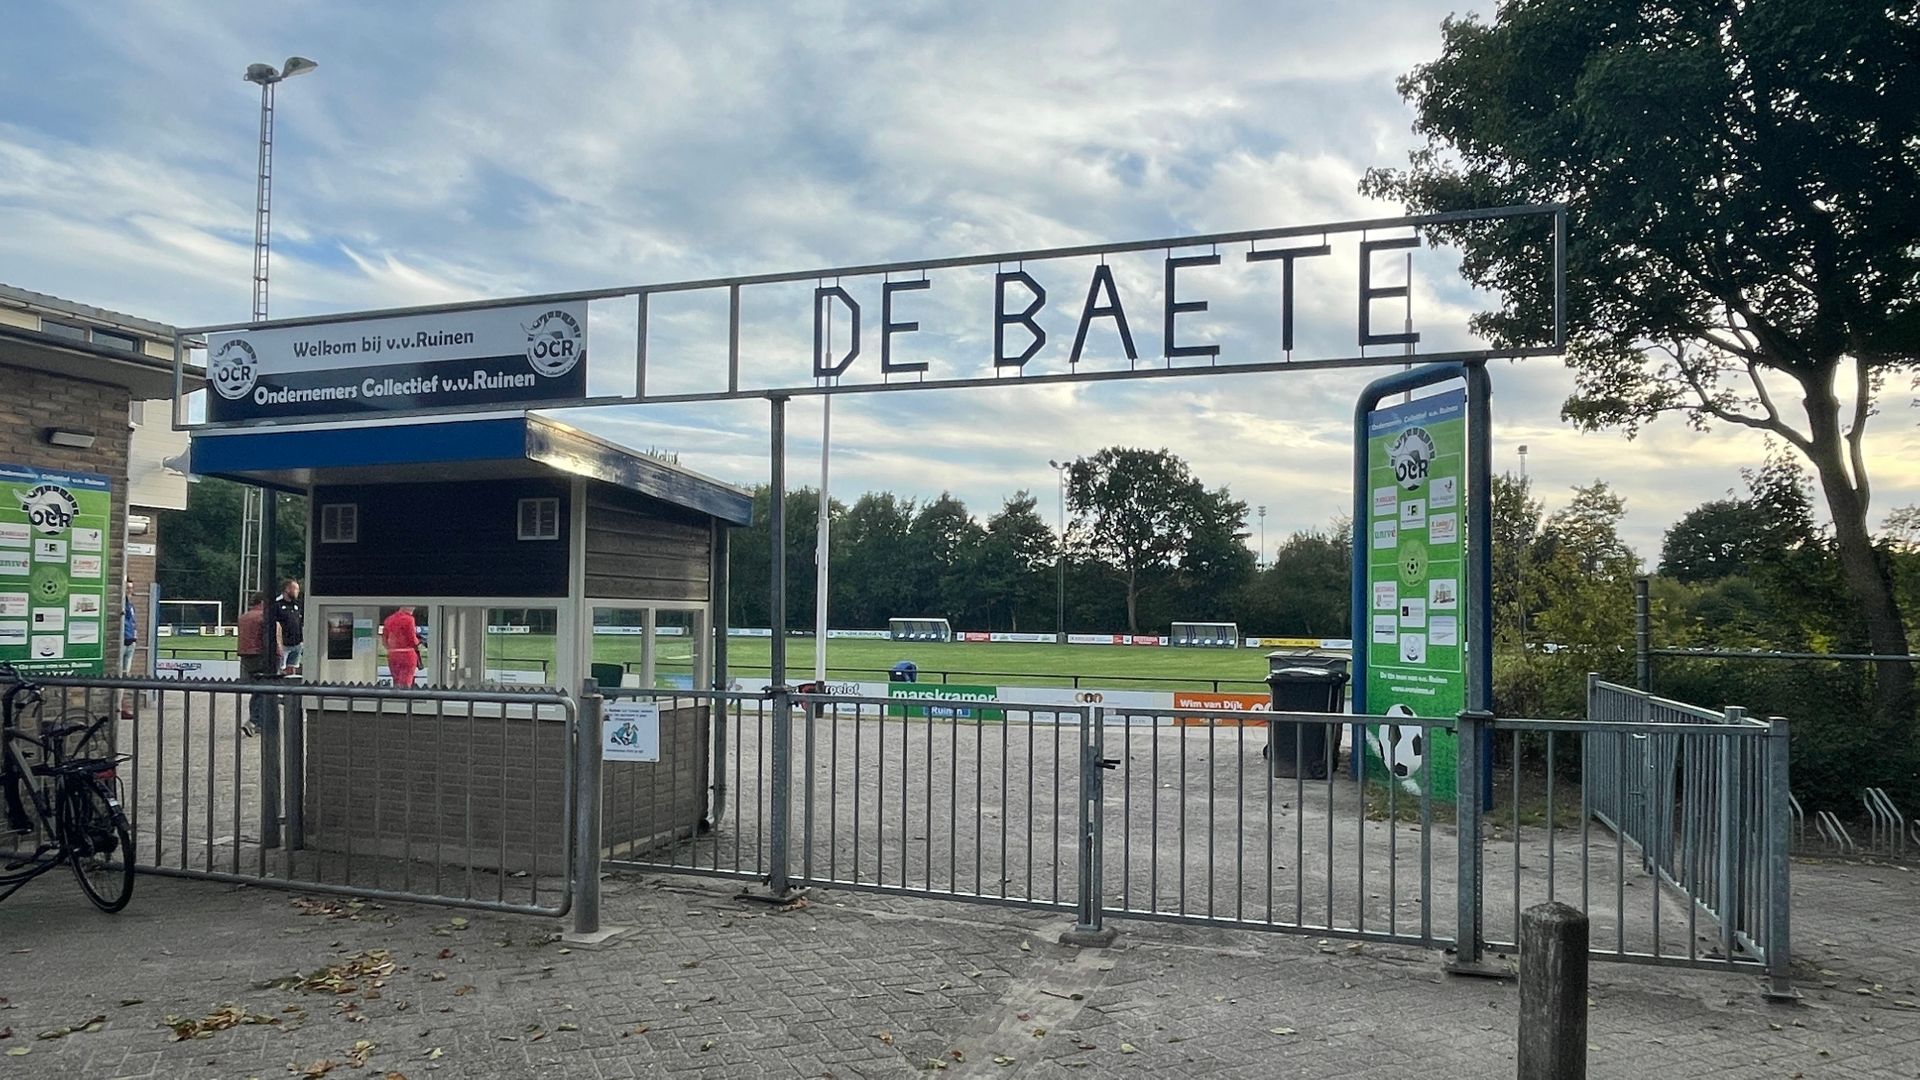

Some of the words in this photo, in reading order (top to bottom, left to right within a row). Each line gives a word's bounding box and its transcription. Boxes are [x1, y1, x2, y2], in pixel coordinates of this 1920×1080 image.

[814, 280, 931, 377] DE
[994, 237, 1421, 367] BAETE
[294, 340, 357, 358] Welkom
[362, 335, 381, 353] bij
[387, 330, 474, 350] v.v.Ruinen
[533, 340, 574, 359] OCR
[218, 365, 251, 383] OCR
[254, 385, 358, 405] Ondernemers
[361, 373, 439, 398] Collectief
[442, 369, 536, 392] v.v.Ruinen
[1395, 459, 1429, 482] OCR
[28, 510, 72, 528] OCR
[892, 688, 996, 701] marskramer
[1180, 699, 1202, 708] Wim
[1223, 700, 1242, 711] Dijk
